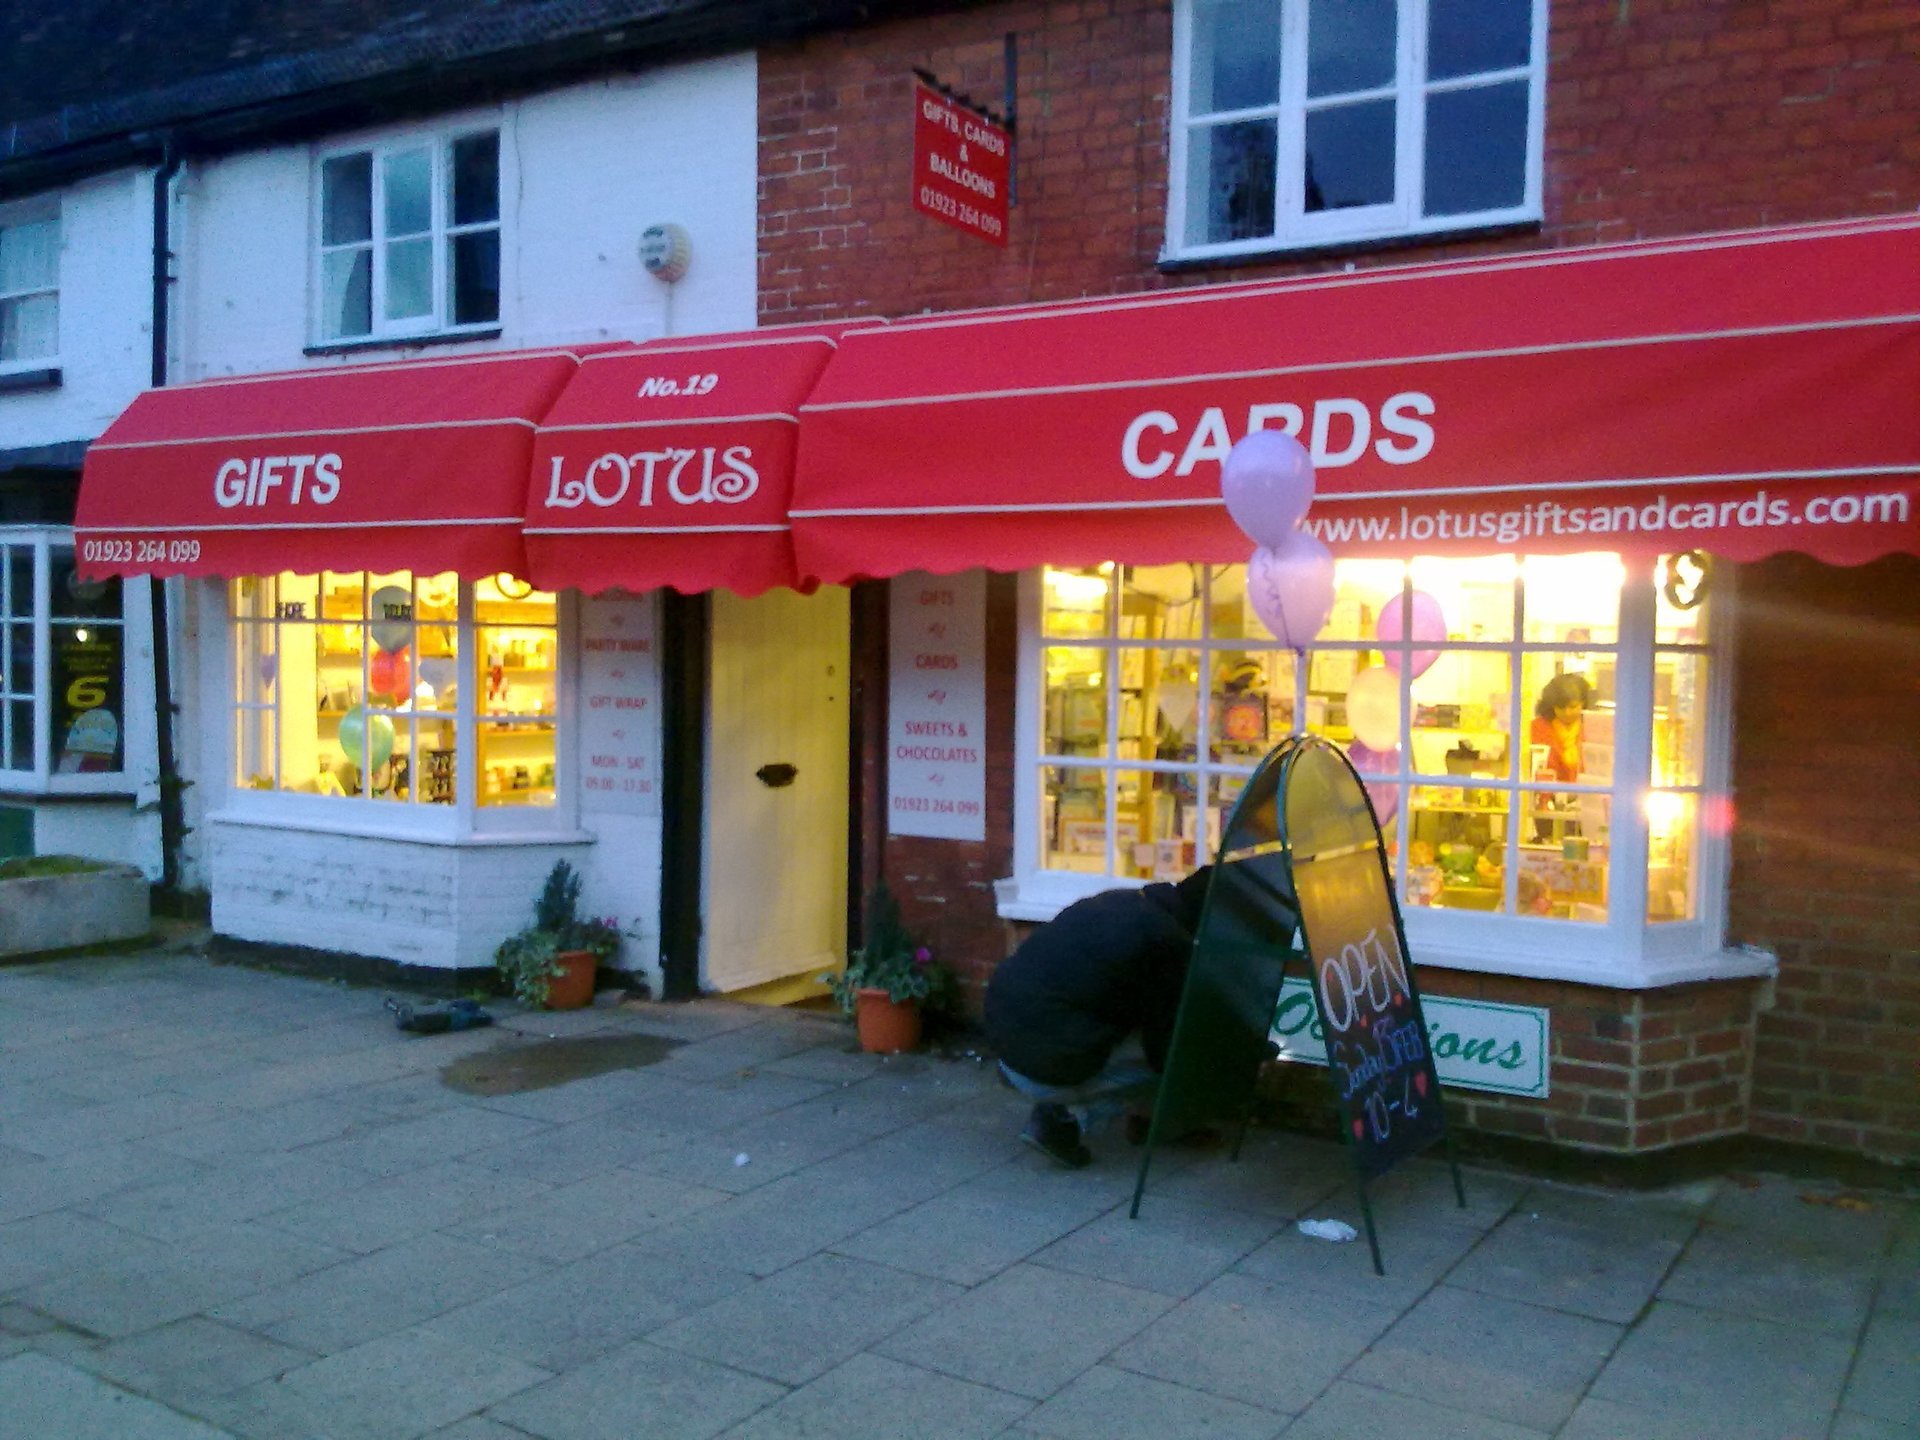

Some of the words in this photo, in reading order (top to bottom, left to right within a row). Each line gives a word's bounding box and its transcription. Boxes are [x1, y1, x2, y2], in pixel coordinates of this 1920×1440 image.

[960, 144, 969, 162] &
[964, 121, 1005, 157] CARDS
[930, 152, 996, 199] BALLOONS
[920, 186, 957, 218] 01923
[959, 203, 979, 228] 264
[981, 217, 1002, 237] 099
[638, 373, 719, 398] No.19
[213, 453, 343, 508] GIFTS
[544, 445, 760, 508] LOTUS
[1301, 491, 1909, 544] www.lotusgiftsandcards.com
[84, 540, 133, 562] 01923
[136, 540, 166, 562] 264
[169, 539, 200, 562] 099
[915, 654, 959, 670] CARDS
[905, 721, 955, 737] SWEETS
[957, 722, 968, 738] &
[896, 745, 978, 764] CHOCOLATES
[894, 797, 930, 813] 01923
[957, 800, 980, 816] 099
[1319, 924, 1411, 1032] OPEN
